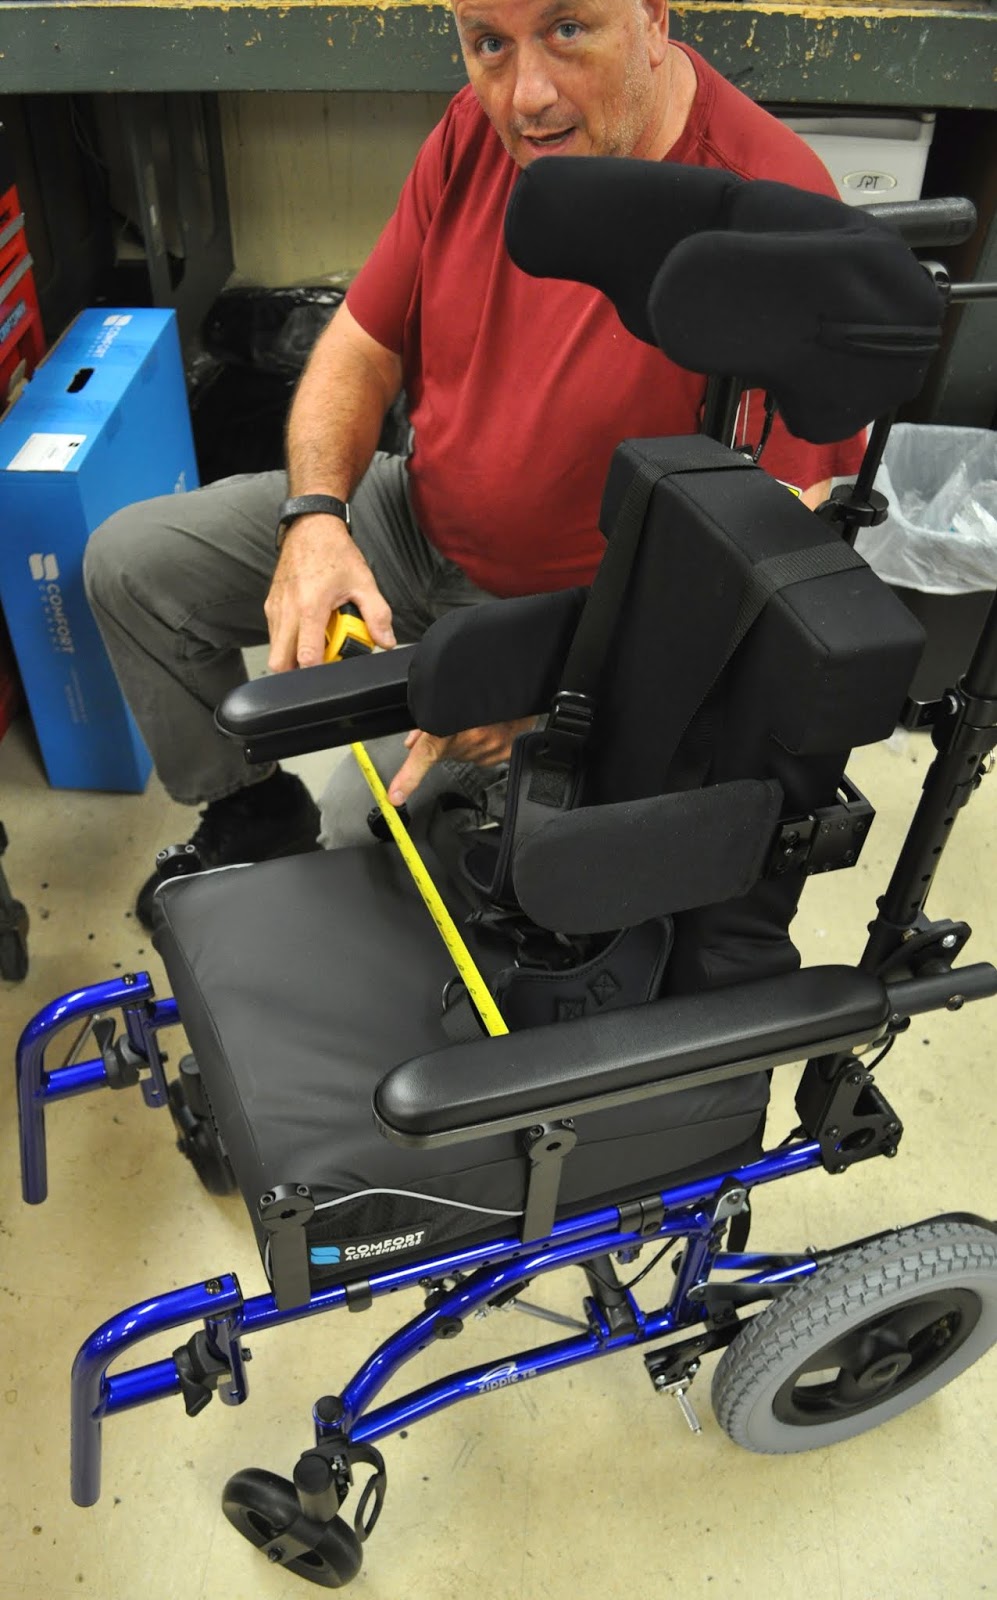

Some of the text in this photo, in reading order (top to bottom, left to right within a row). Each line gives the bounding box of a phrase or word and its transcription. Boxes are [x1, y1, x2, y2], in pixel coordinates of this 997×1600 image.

[856, 175, 880, 190] SPT
[47, 584, 74, 653] COMFORT
[344, 1231, 425, 1255] COMFORT
